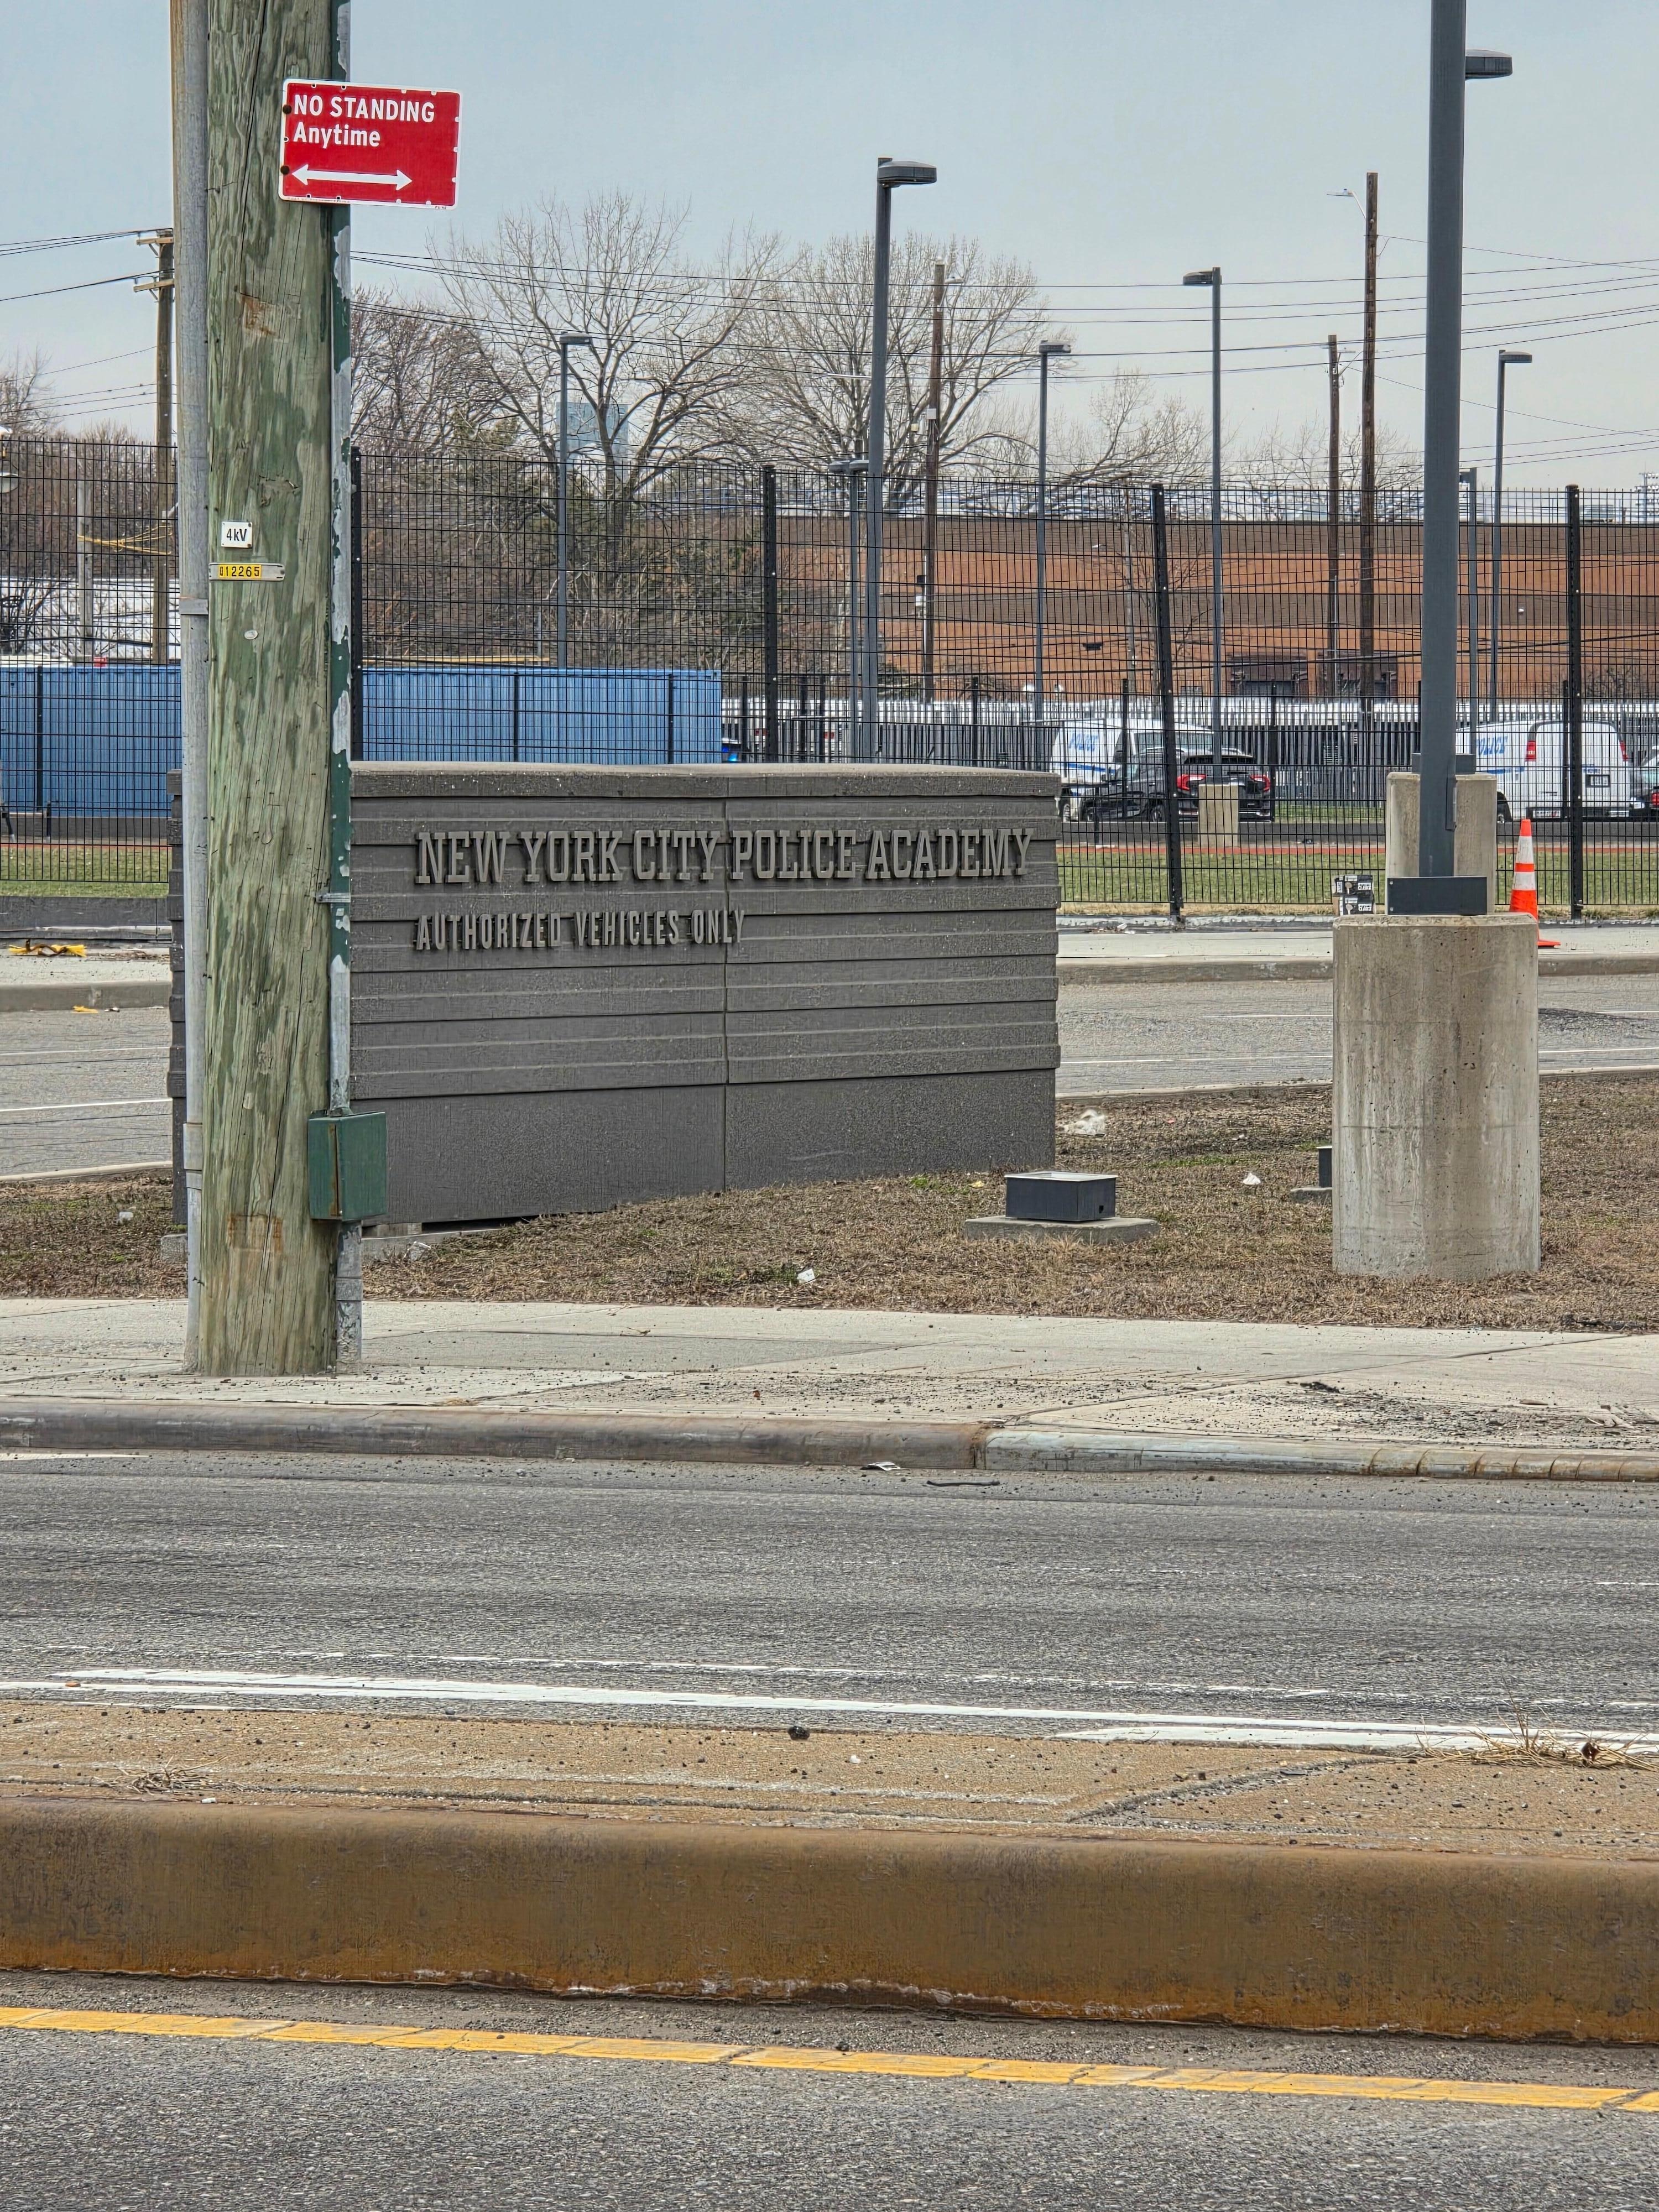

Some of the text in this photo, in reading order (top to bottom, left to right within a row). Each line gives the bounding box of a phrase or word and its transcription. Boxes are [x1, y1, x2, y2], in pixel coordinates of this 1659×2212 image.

[294, 94, 435, 123] NO STANDING
[293, 122, 381, 149] Anytime
[226, 528, 247, 542] 4kV
[415, 828, 1036, 884] NEW YORK CITY POLICE ACADEMY
[415, 909, 745, 951] AUTHORIZED VEHICLES ONLY
